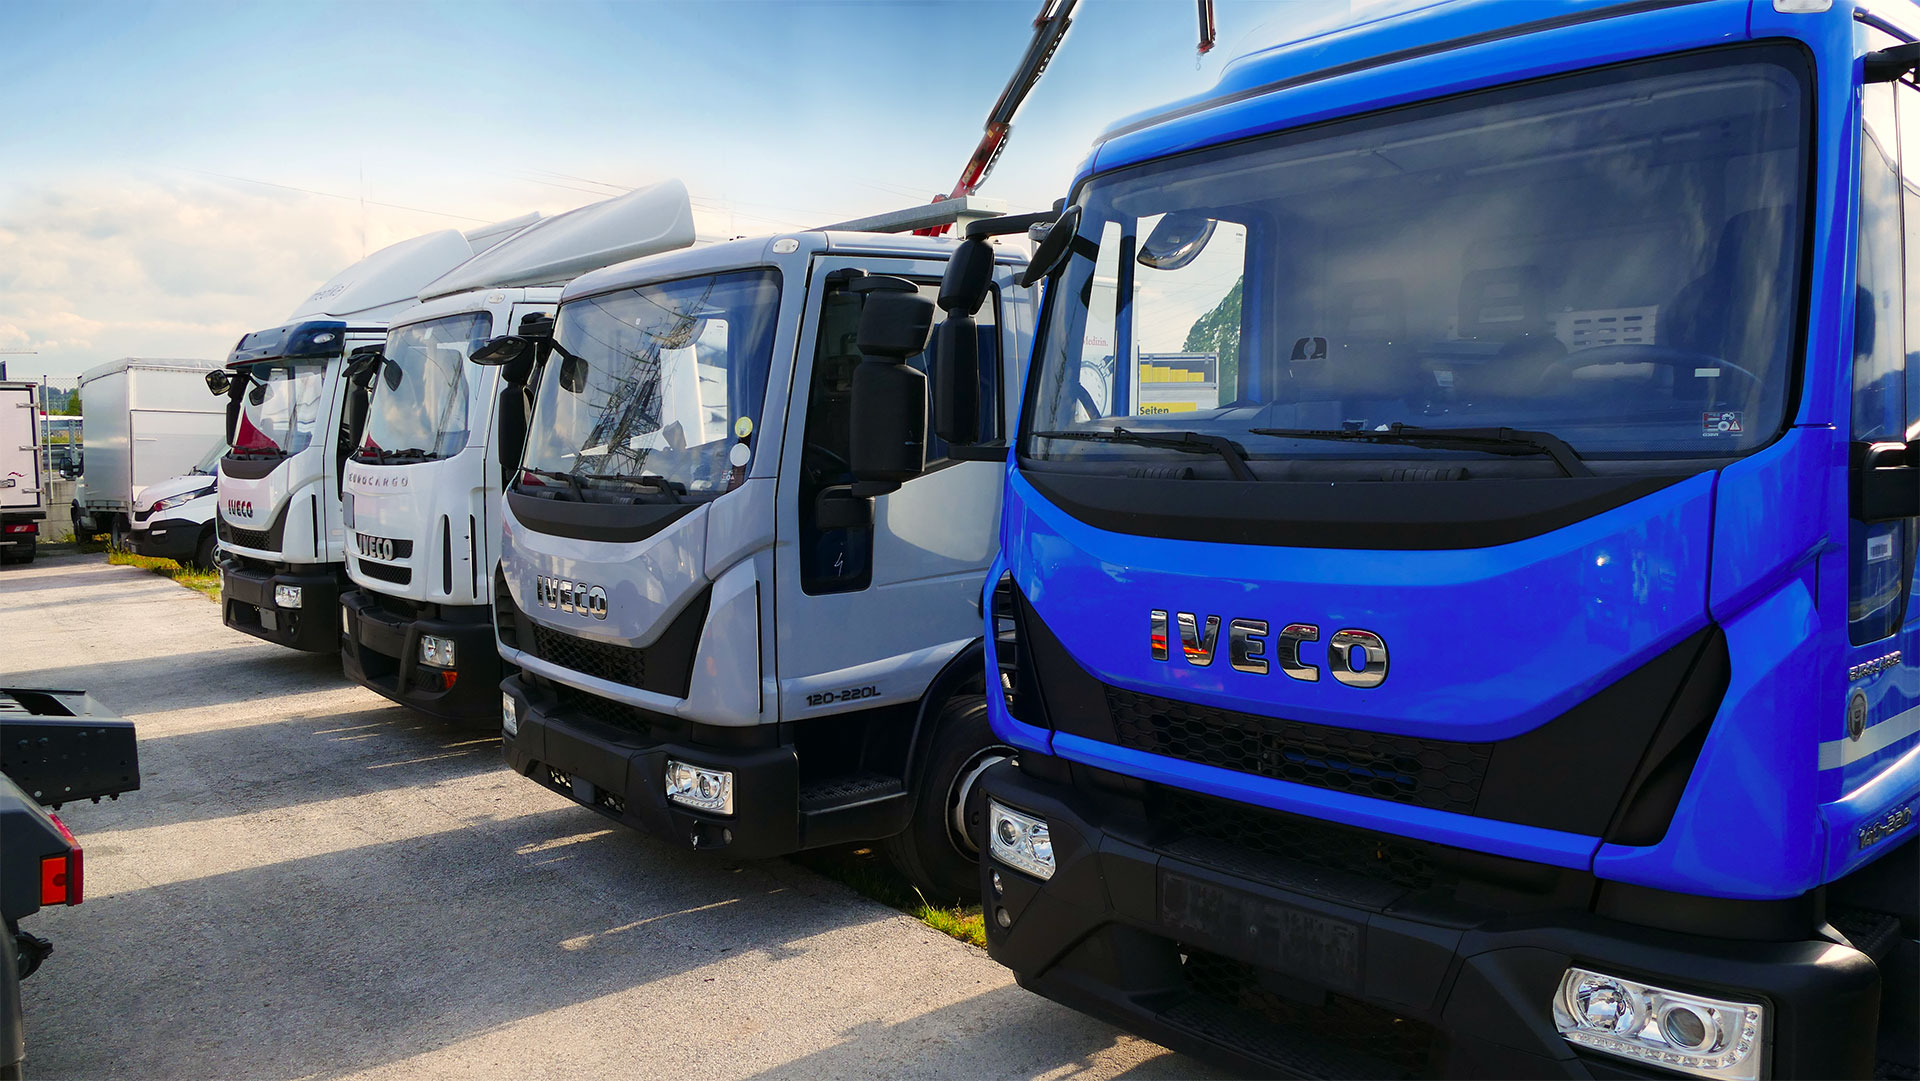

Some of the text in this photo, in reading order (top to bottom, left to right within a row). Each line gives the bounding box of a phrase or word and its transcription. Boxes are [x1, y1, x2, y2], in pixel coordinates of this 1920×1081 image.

[1139, 405, 1169, 415] Seiten
[349, 473, 408, 487] EUROCARGO
[228, 499, 254, 518] IVECO
[358, 534, 393, 561] IVECO
[536, 574, 608, 621] IVECO
[1150, 608, 1391, 690] IVECO
[806, 686, 881, 706] 120-220L
